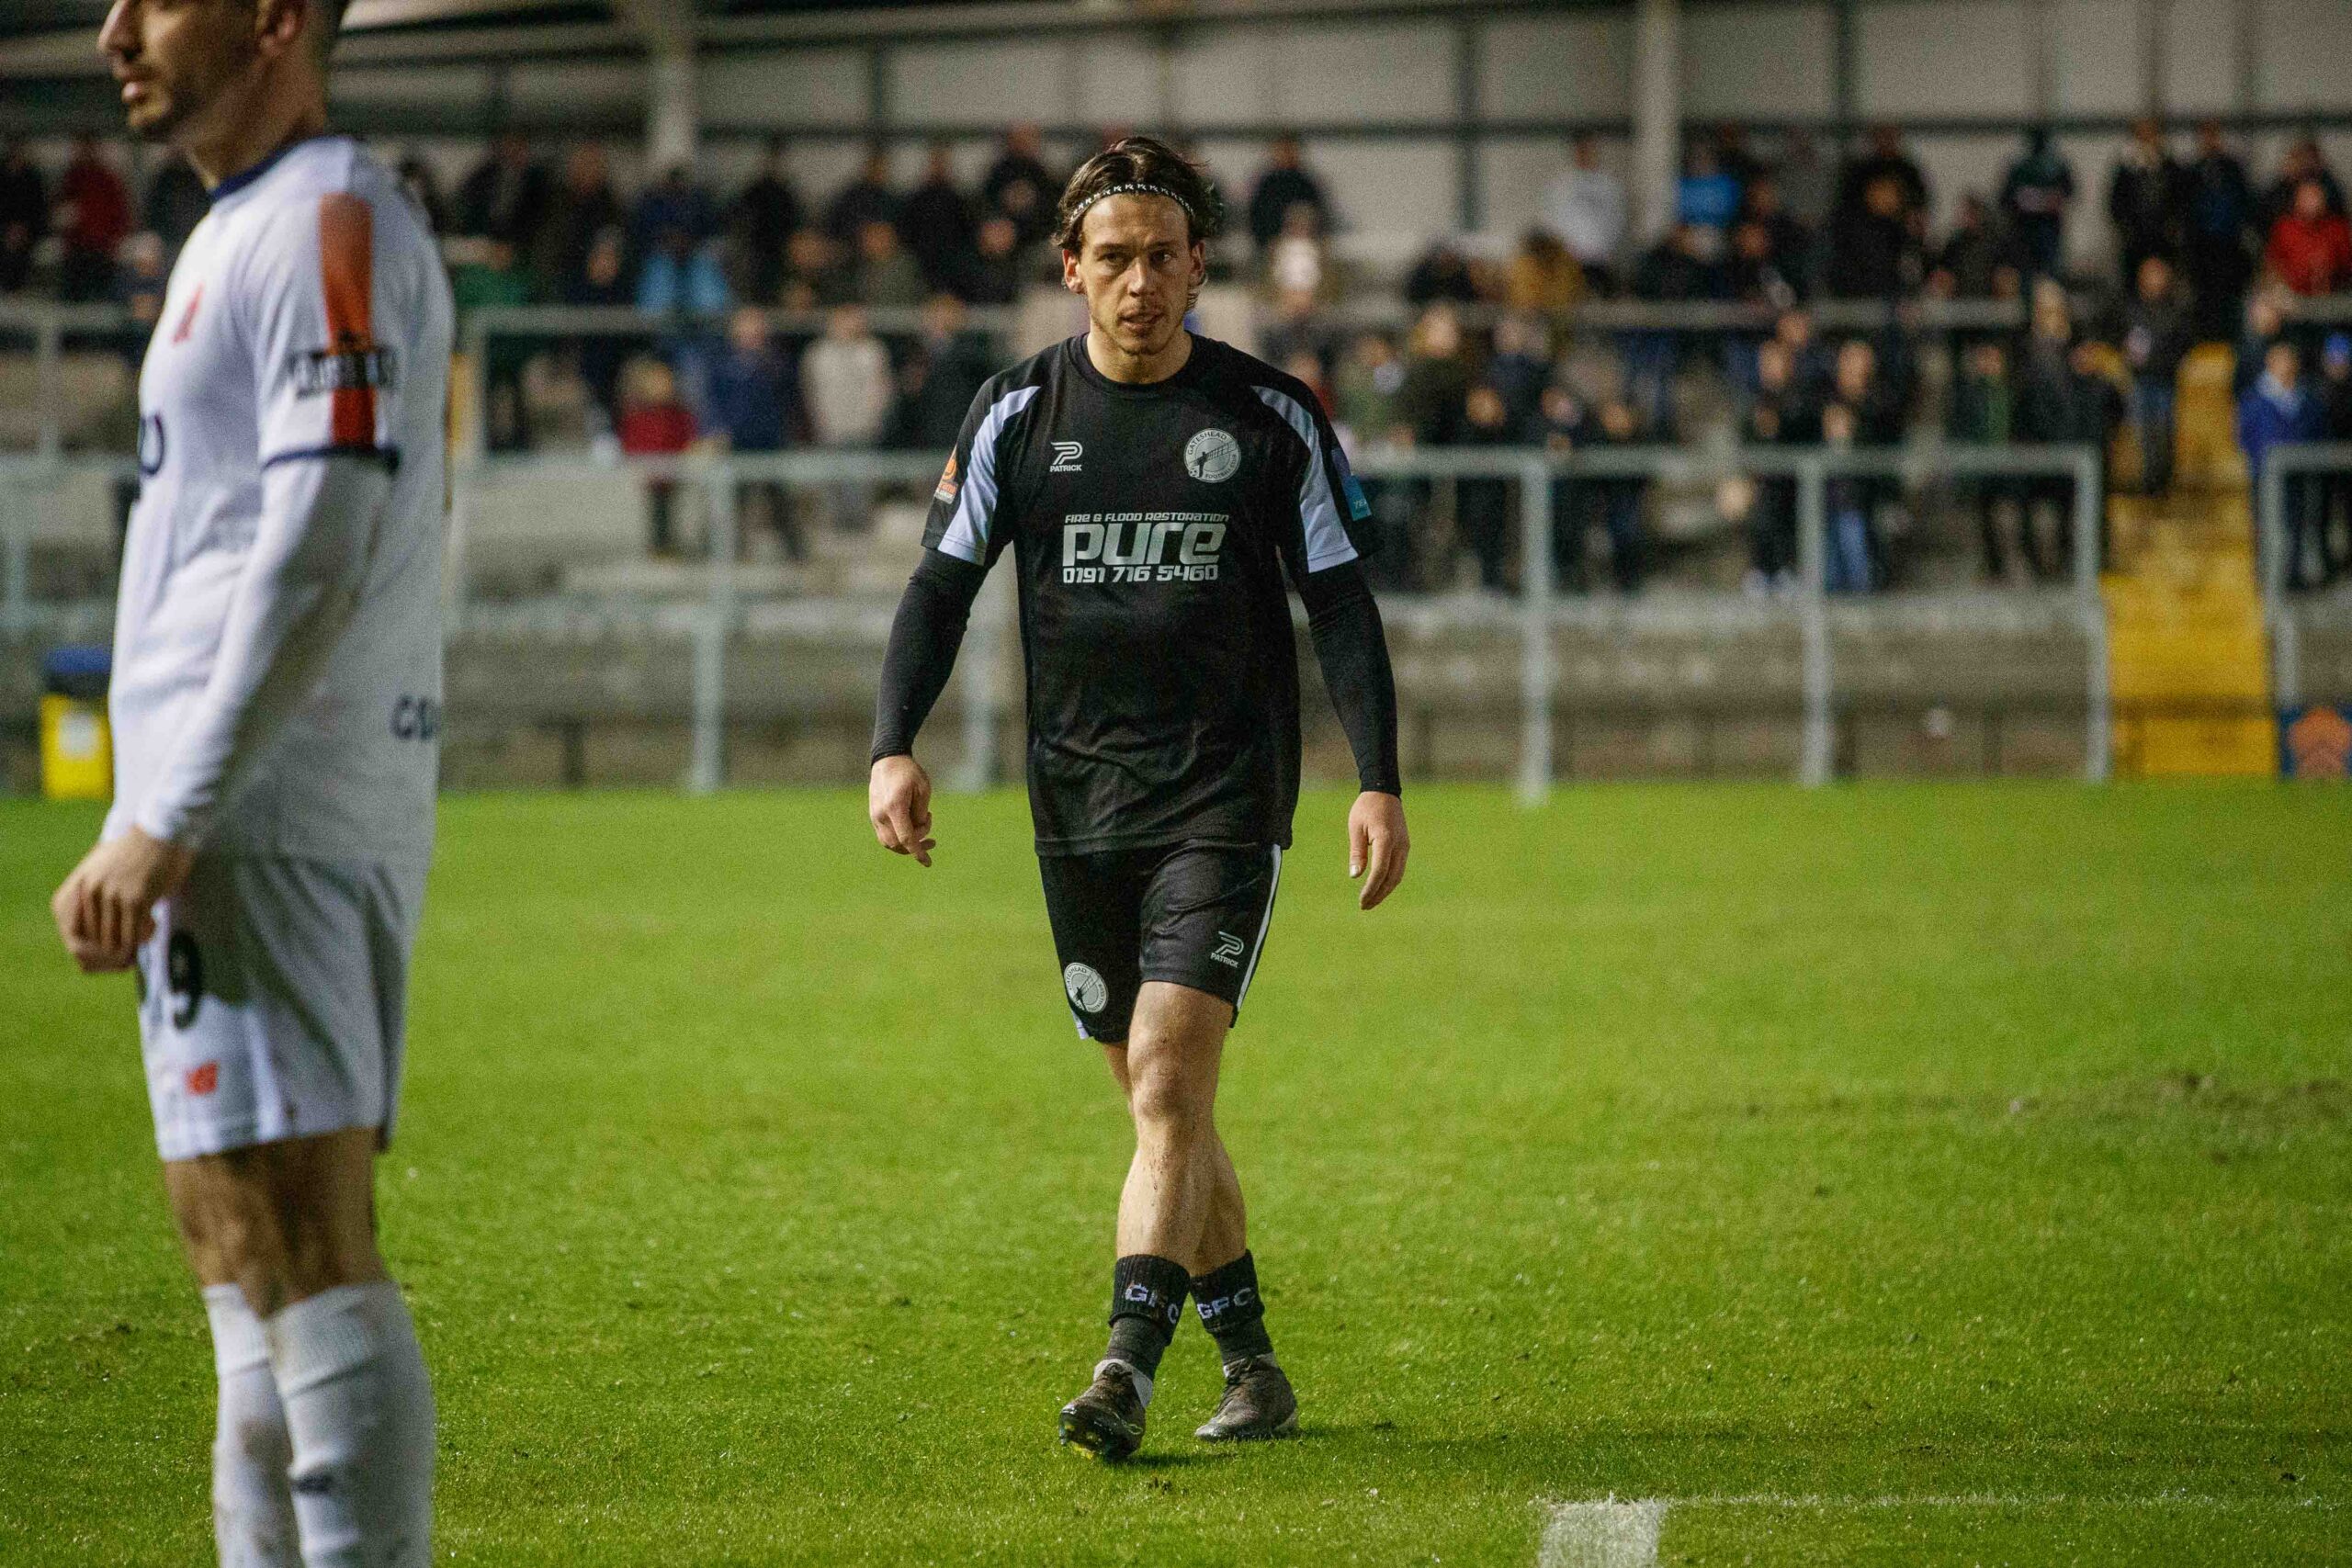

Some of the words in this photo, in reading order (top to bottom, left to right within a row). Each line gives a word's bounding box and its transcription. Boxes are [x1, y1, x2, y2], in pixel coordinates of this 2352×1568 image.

[1187, 431, 1227, 456] GATESHEAD
[1049, 464, 1082, 472] PATRICK
[1104, 513, 1143, 522] FLOOD
[1063, 567, 1106, 583] 0191
[1112, 566, 1152, 582] 716
[1156, 564, 1219, 581] 5460
[1210, 952, 1238, 968] PATRICK
[168, 931, 203, 1033] 9
